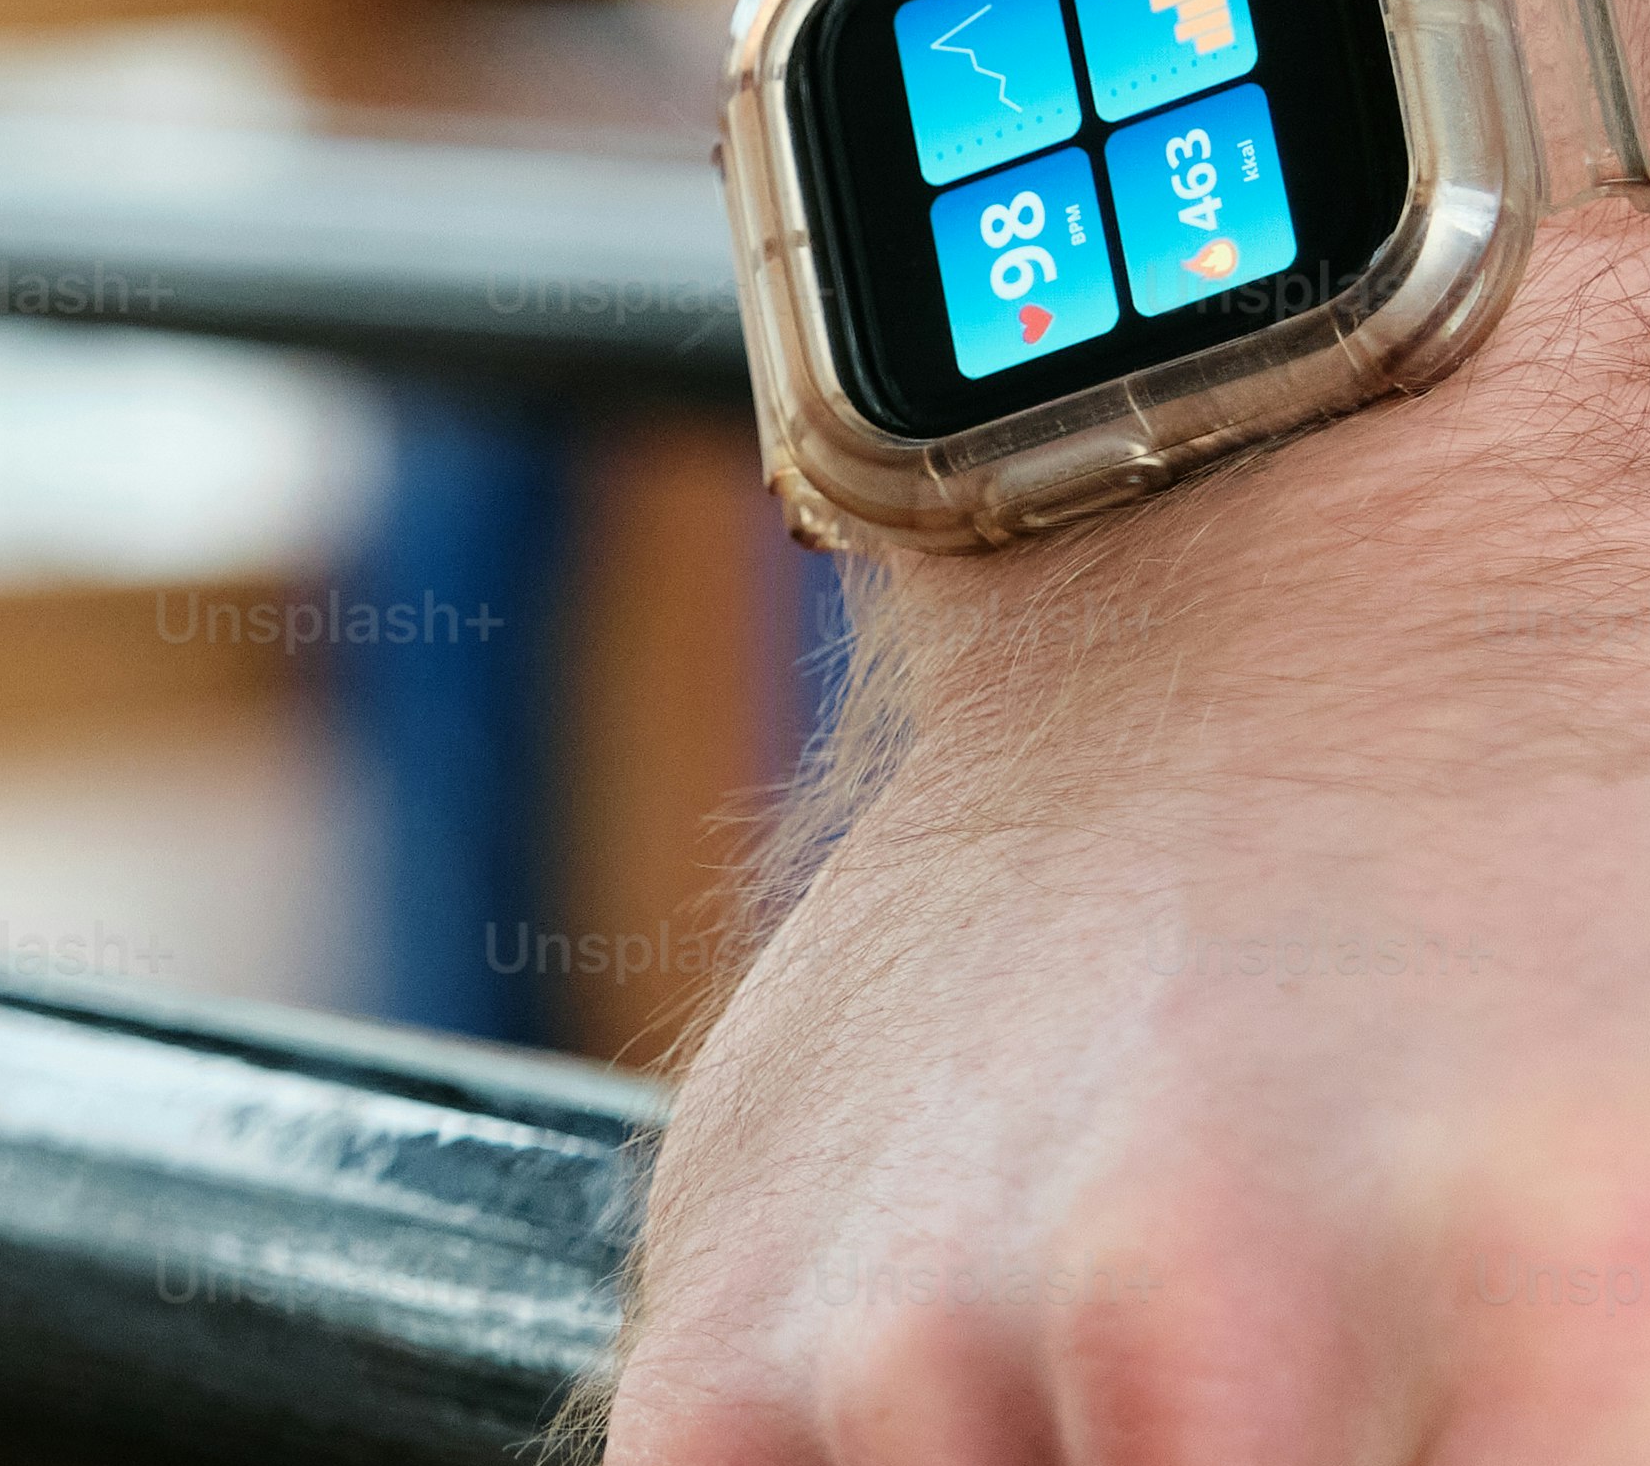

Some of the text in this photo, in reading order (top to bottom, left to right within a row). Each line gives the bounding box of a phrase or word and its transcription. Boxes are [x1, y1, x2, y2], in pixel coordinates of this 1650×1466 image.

[1166, 128, 1223, 231] 463
[1237, 139, 1260, 182] kkal
[980, 191, 1058, 300] 98
[1065, 204, 1087, 246] BPM
